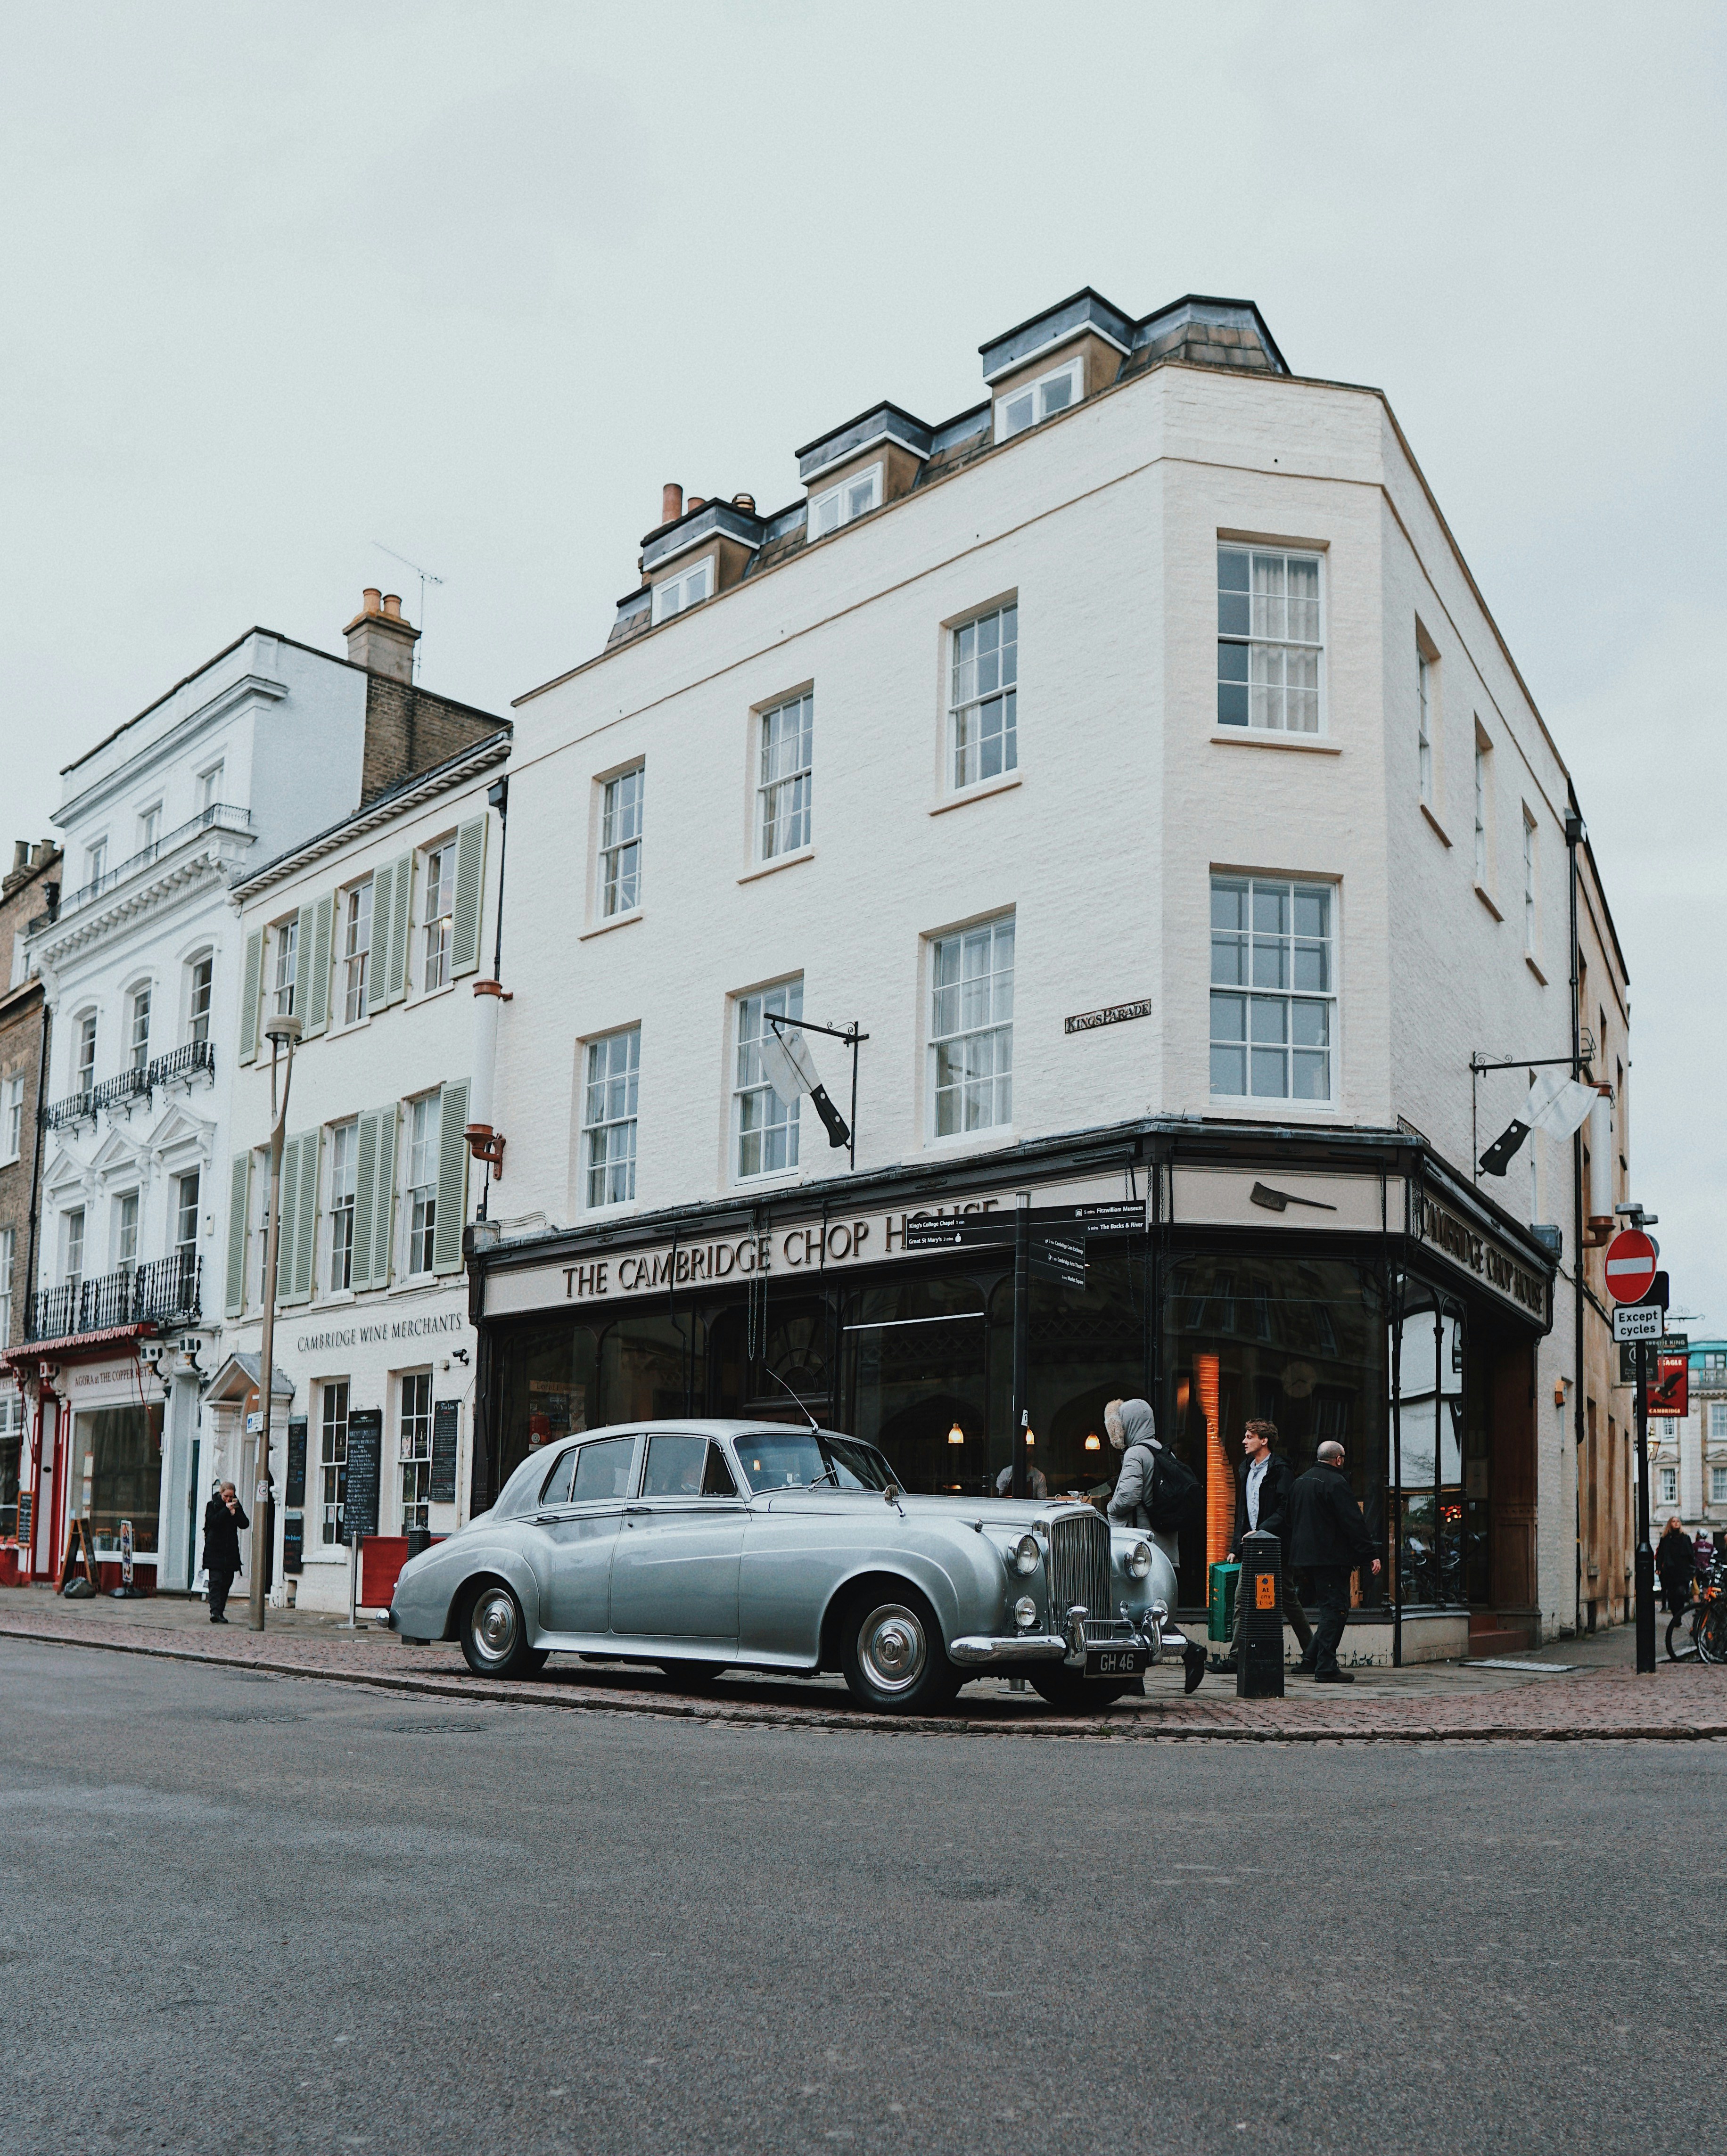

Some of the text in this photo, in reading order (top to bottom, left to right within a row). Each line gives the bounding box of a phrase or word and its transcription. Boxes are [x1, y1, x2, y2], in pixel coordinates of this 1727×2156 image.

[563, 1262, 608, 1297] THE
[618, 1237, 771, 1289] CAMBRIDGE
[783, 1221, 869, 1265] CHOP
[1619, 1310, 1658, 1322] Except
[297, 1312, 462, 1352] CAMBRIDGE WINE MERCHANTS
[1620, 1324, 1656, 1336] cycles
[75, 1375, 94, 1387] AGORA
[100, 1371, 111, 1383] THE
[112, 1368, 134, 1382] COPPER
[1101, 1653, 1134, 1671] GH 46
